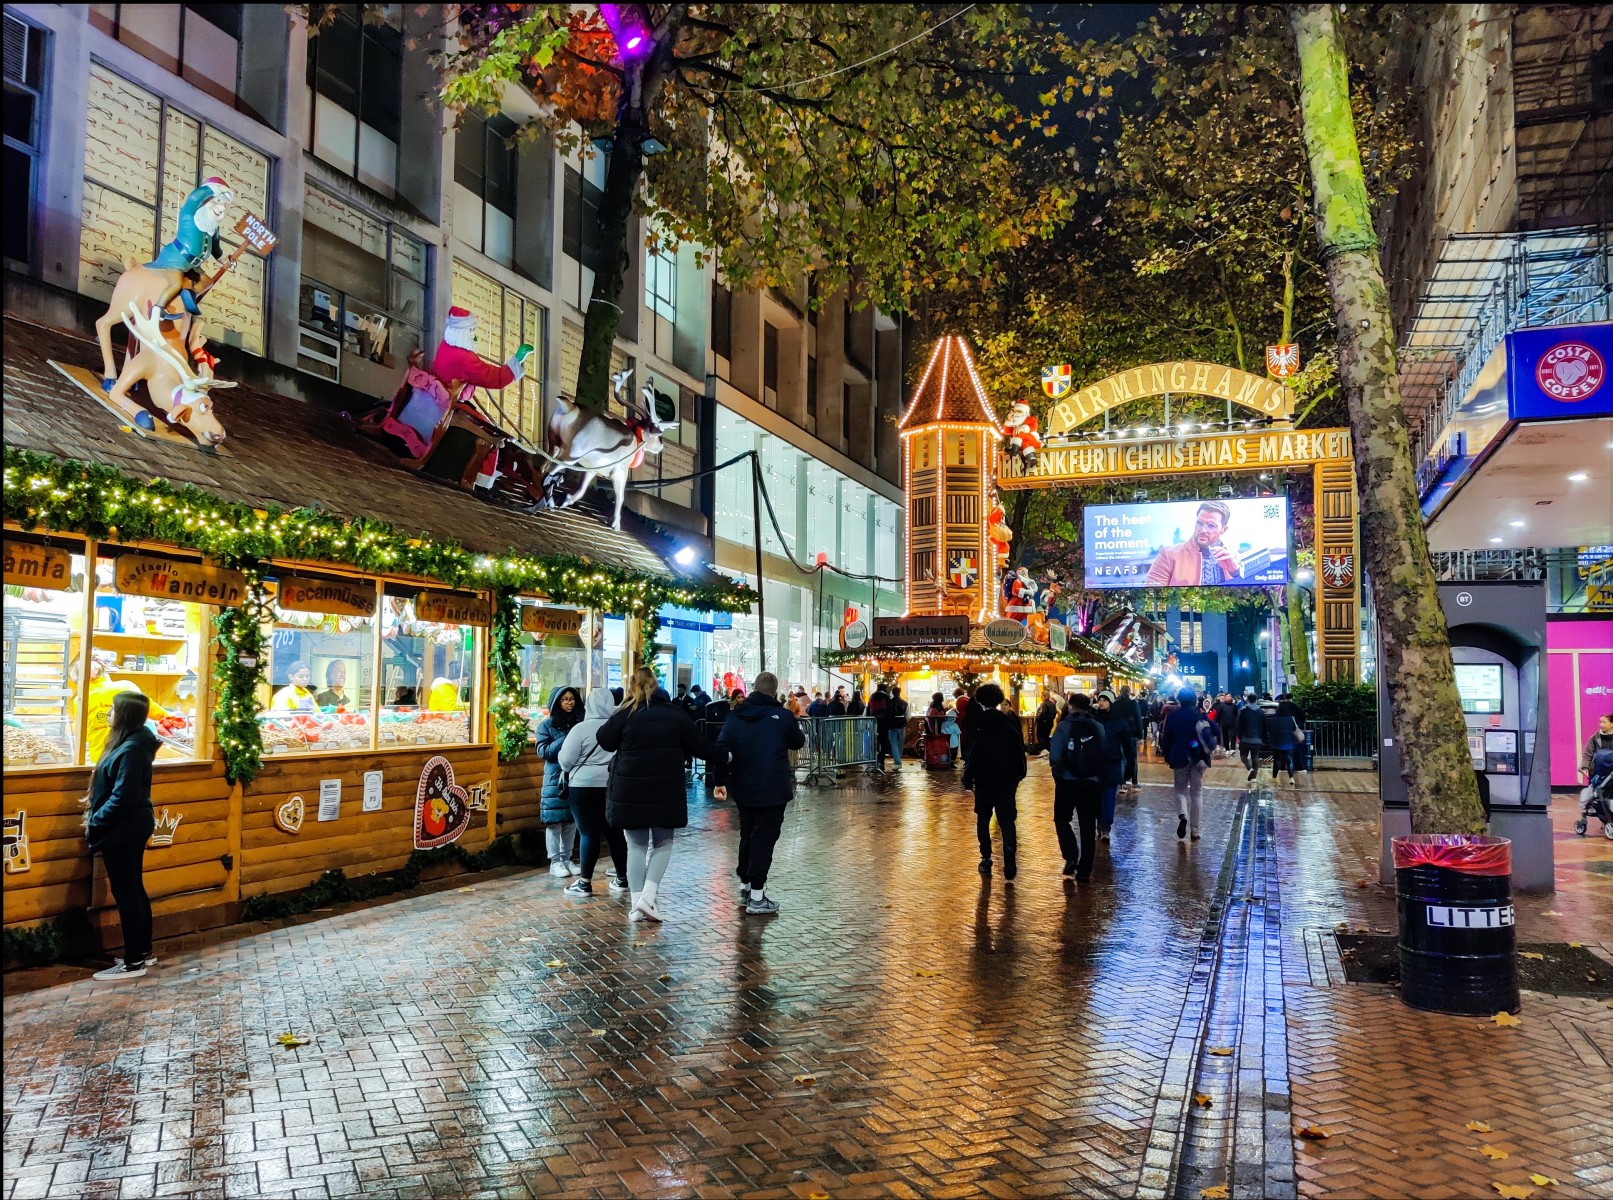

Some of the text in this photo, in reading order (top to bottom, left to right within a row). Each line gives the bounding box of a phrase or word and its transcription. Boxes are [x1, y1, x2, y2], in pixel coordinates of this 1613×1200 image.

[242, 227, 266, 249] POLE
[245, 215, 277, 245] NORTH
[1547, 347, 1591, 364] COSTA
[1056, 363, 1284, 428] BIRMINGHAM'S
[1545, 375, 1598, 397] COFFEE
[1125, 438, 1247, 471] CHRISTMAS
[1258, 431, 1350, 463] MARKET
[1094, 515, 1119, 527] The
[1094, 526, 1133, 539] of the
[121, 562, 179, 589] Raffaello
[150, 572, 239, 601] Mandeln
[536, 616, 577, 632] Mandeln
[879, 625, 964, 637] Rostbratwurst
